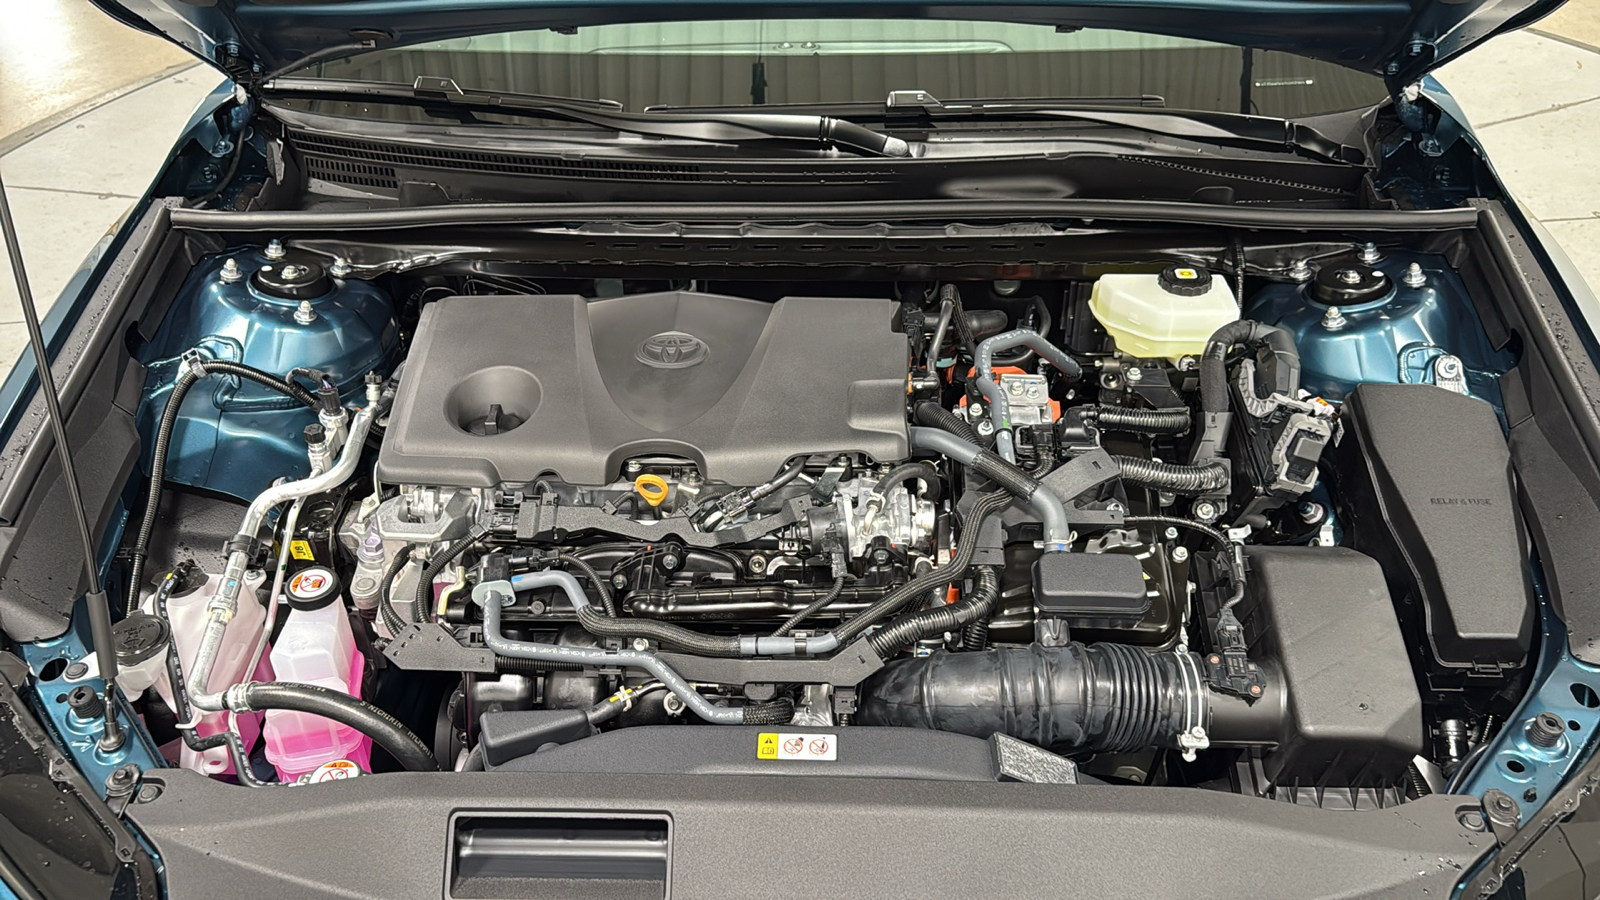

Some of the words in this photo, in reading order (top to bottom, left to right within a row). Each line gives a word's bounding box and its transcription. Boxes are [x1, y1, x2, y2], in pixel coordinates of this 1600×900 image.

[1430, 497, 1458, 506] RELAY
[1460, 498, 1467, 506] &
[1467, 498, 1492, 506] FUSE
